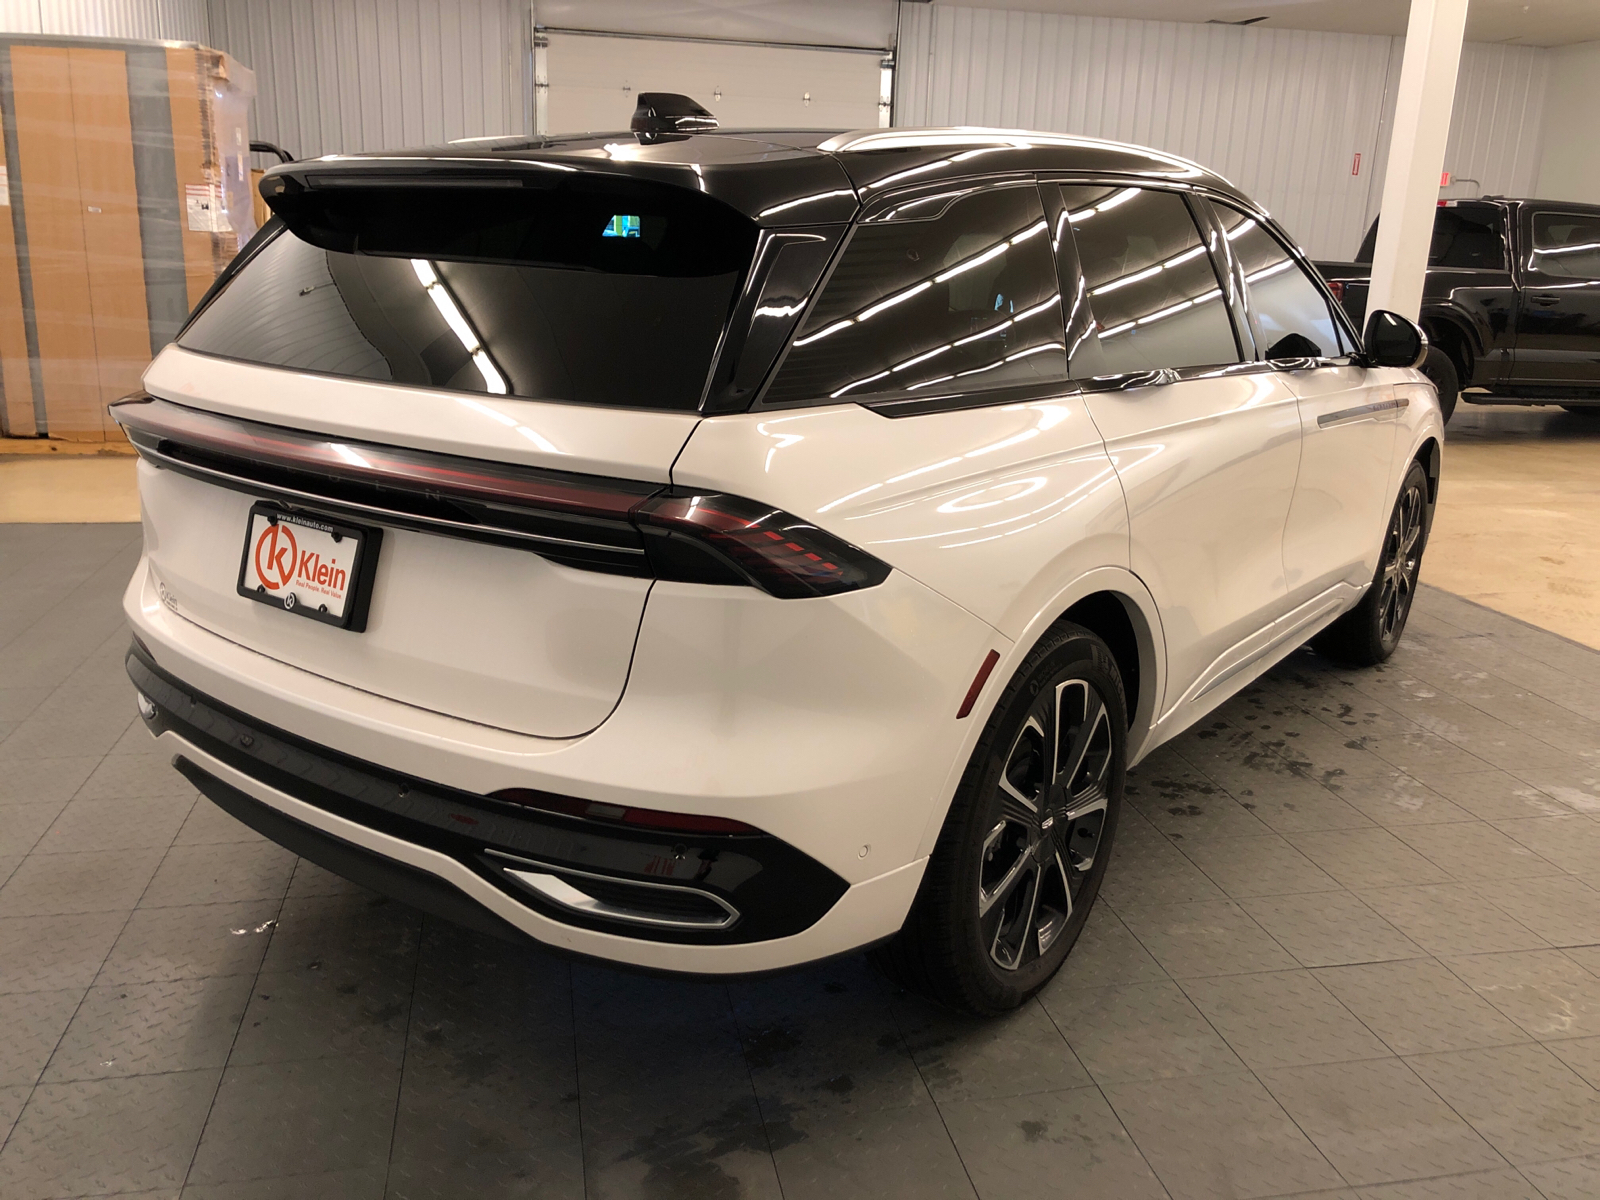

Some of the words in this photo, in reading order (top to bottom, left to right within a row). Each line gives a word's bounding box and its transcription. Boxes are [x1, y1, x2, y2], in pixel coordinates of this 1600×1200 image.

[276, 513, 334, 532] www.kleinauto.com
[297, 550, 346, 591] Klein
[296, 579, 306, 588] Real
[321, 587, 330, 595] Real
